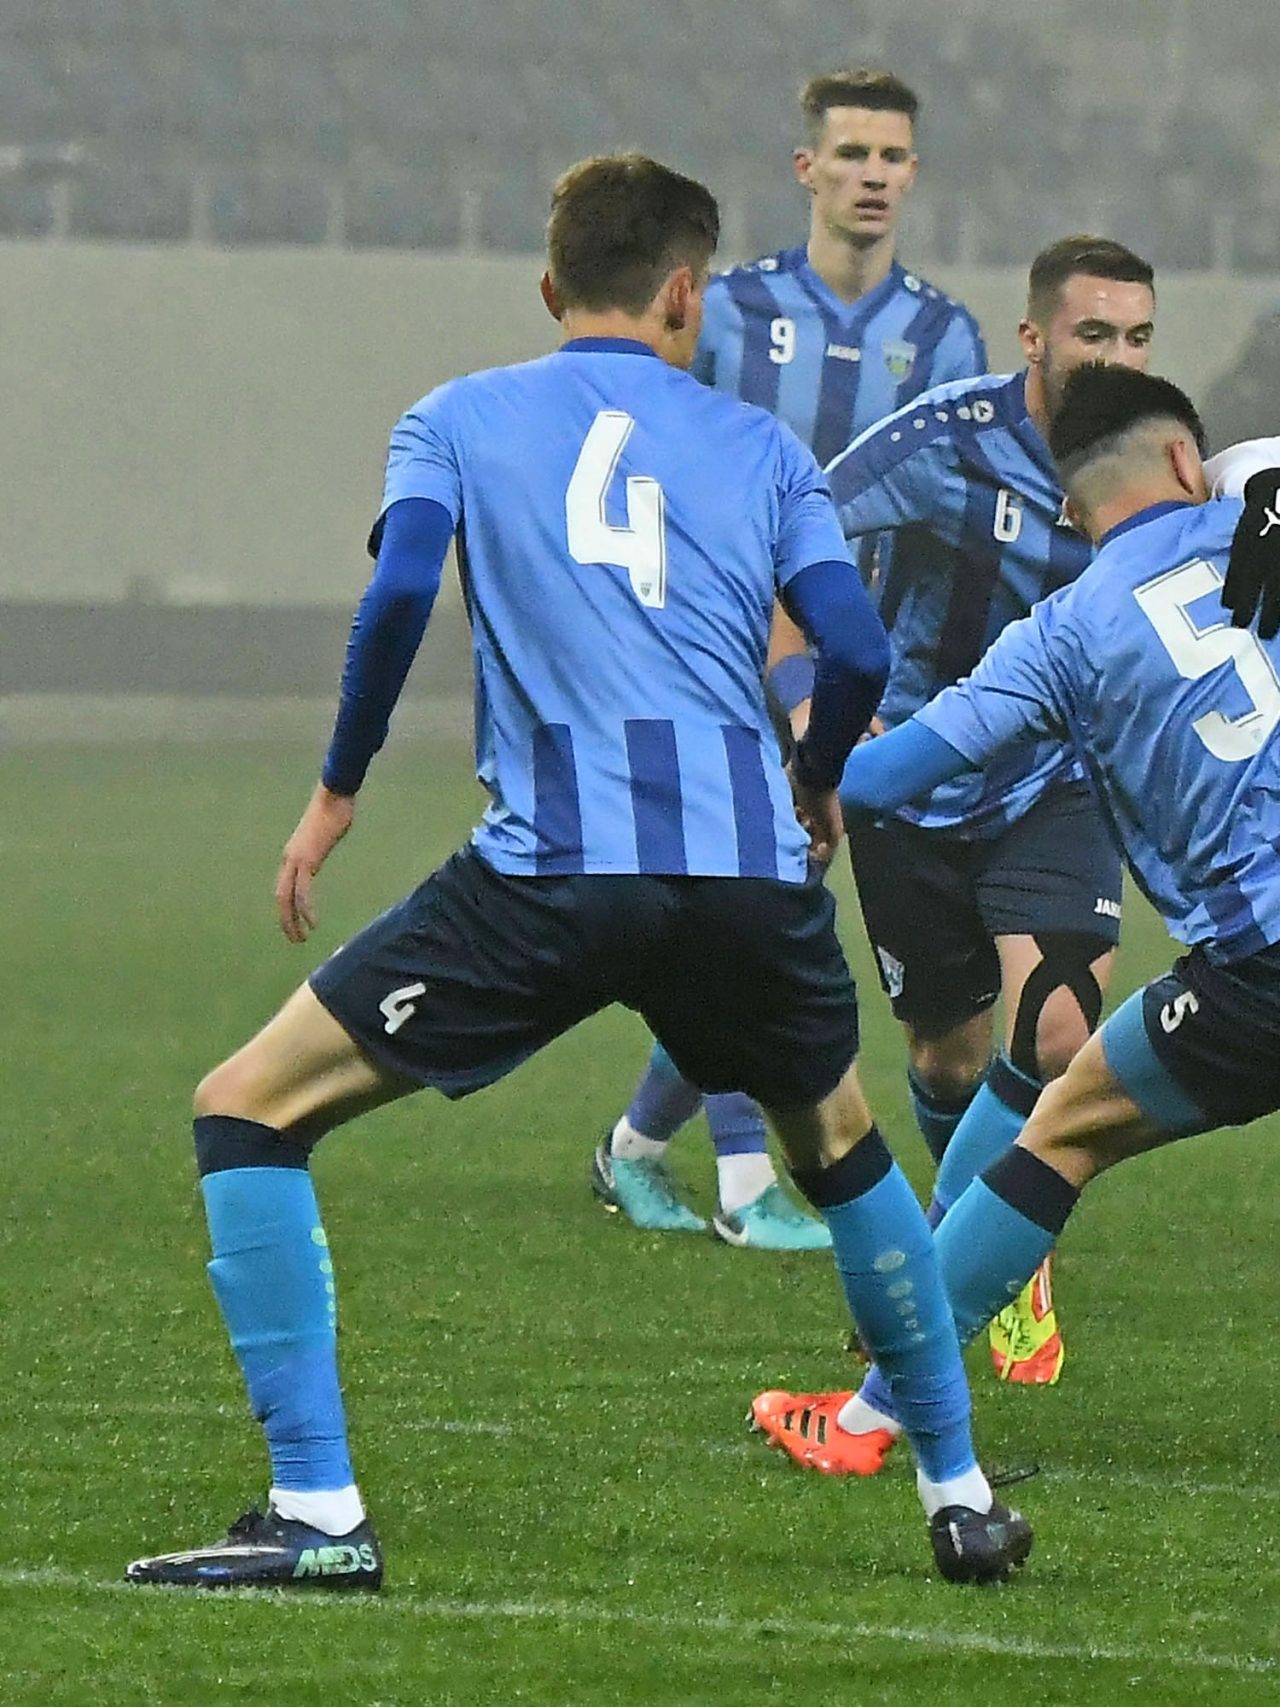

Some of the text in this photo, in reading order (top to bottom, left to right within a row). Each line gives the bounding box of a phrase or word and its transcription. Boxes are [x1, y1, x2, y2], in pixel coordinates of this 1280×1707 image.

[769, 317, 796, 365] 9
[565, 410, 665, 609] 4
[993, 489, 1022, 543] 6
[379, 981, 427, 1035] 4
[1160, 990, 1199, 1034] 5
